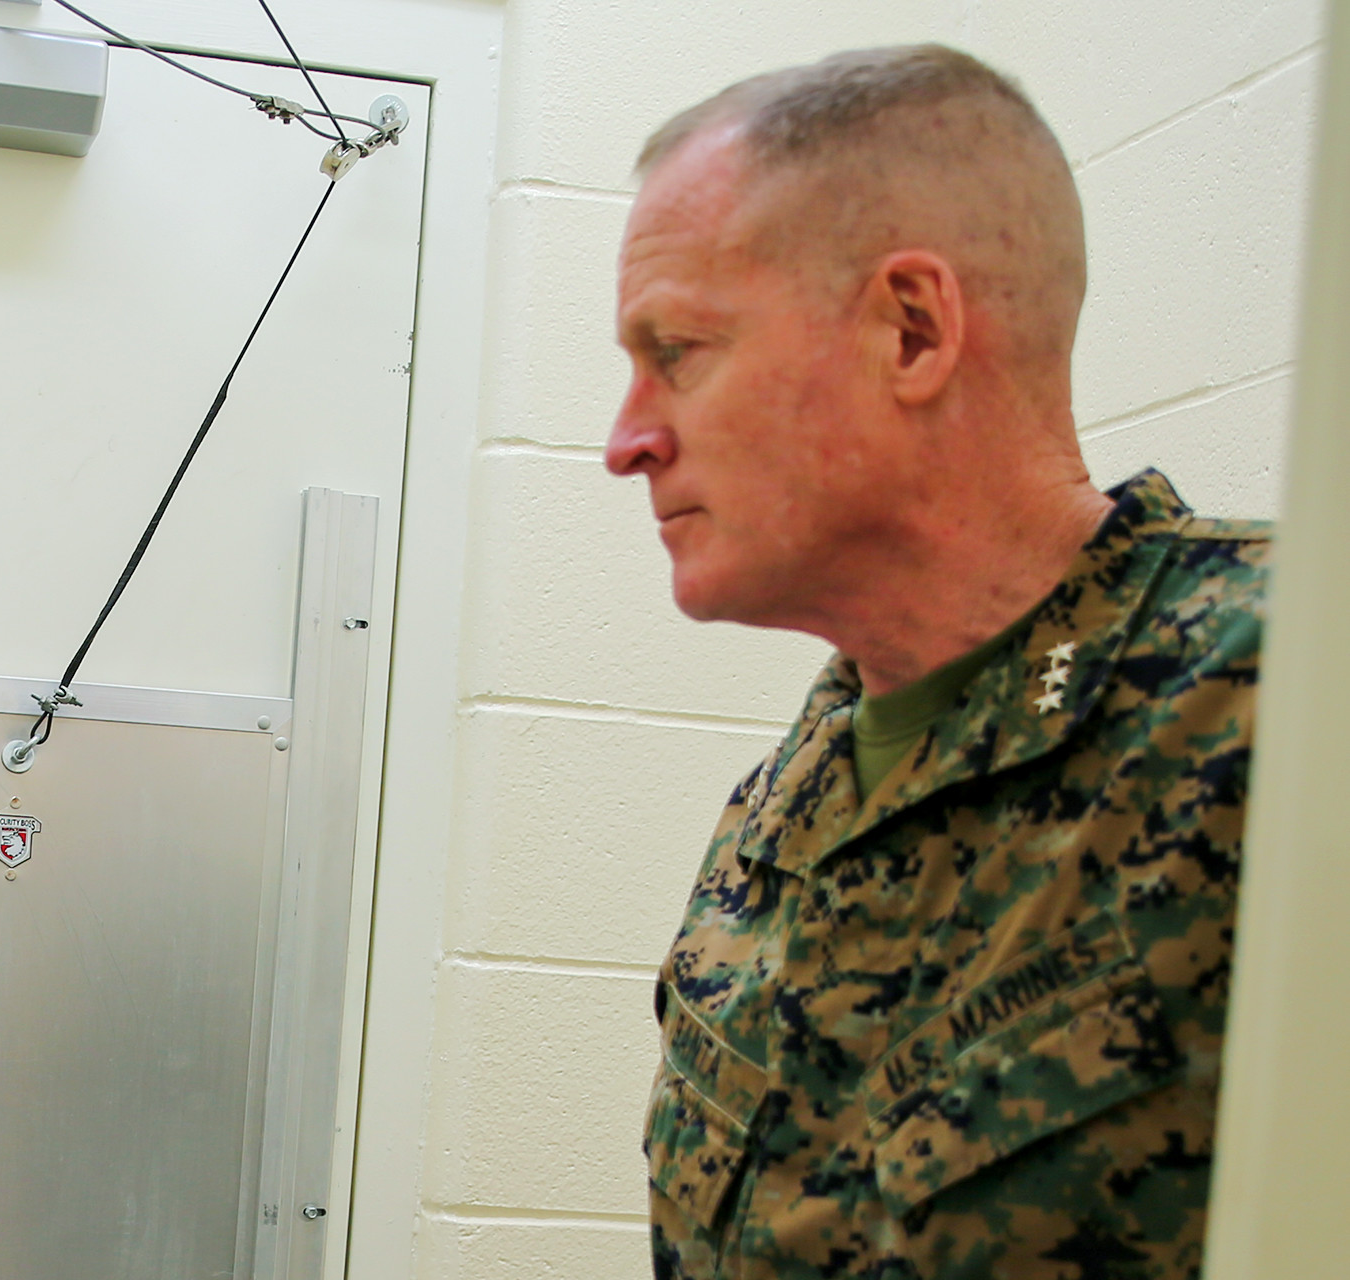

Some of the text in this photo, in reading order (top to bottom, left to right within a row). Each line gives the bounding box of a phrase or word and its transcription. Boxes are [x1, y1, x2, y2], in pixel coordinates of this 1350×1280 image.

[21, 819, 36, 831] BOSS
[885, 938, 1098, 1095] U.S. MARINES
